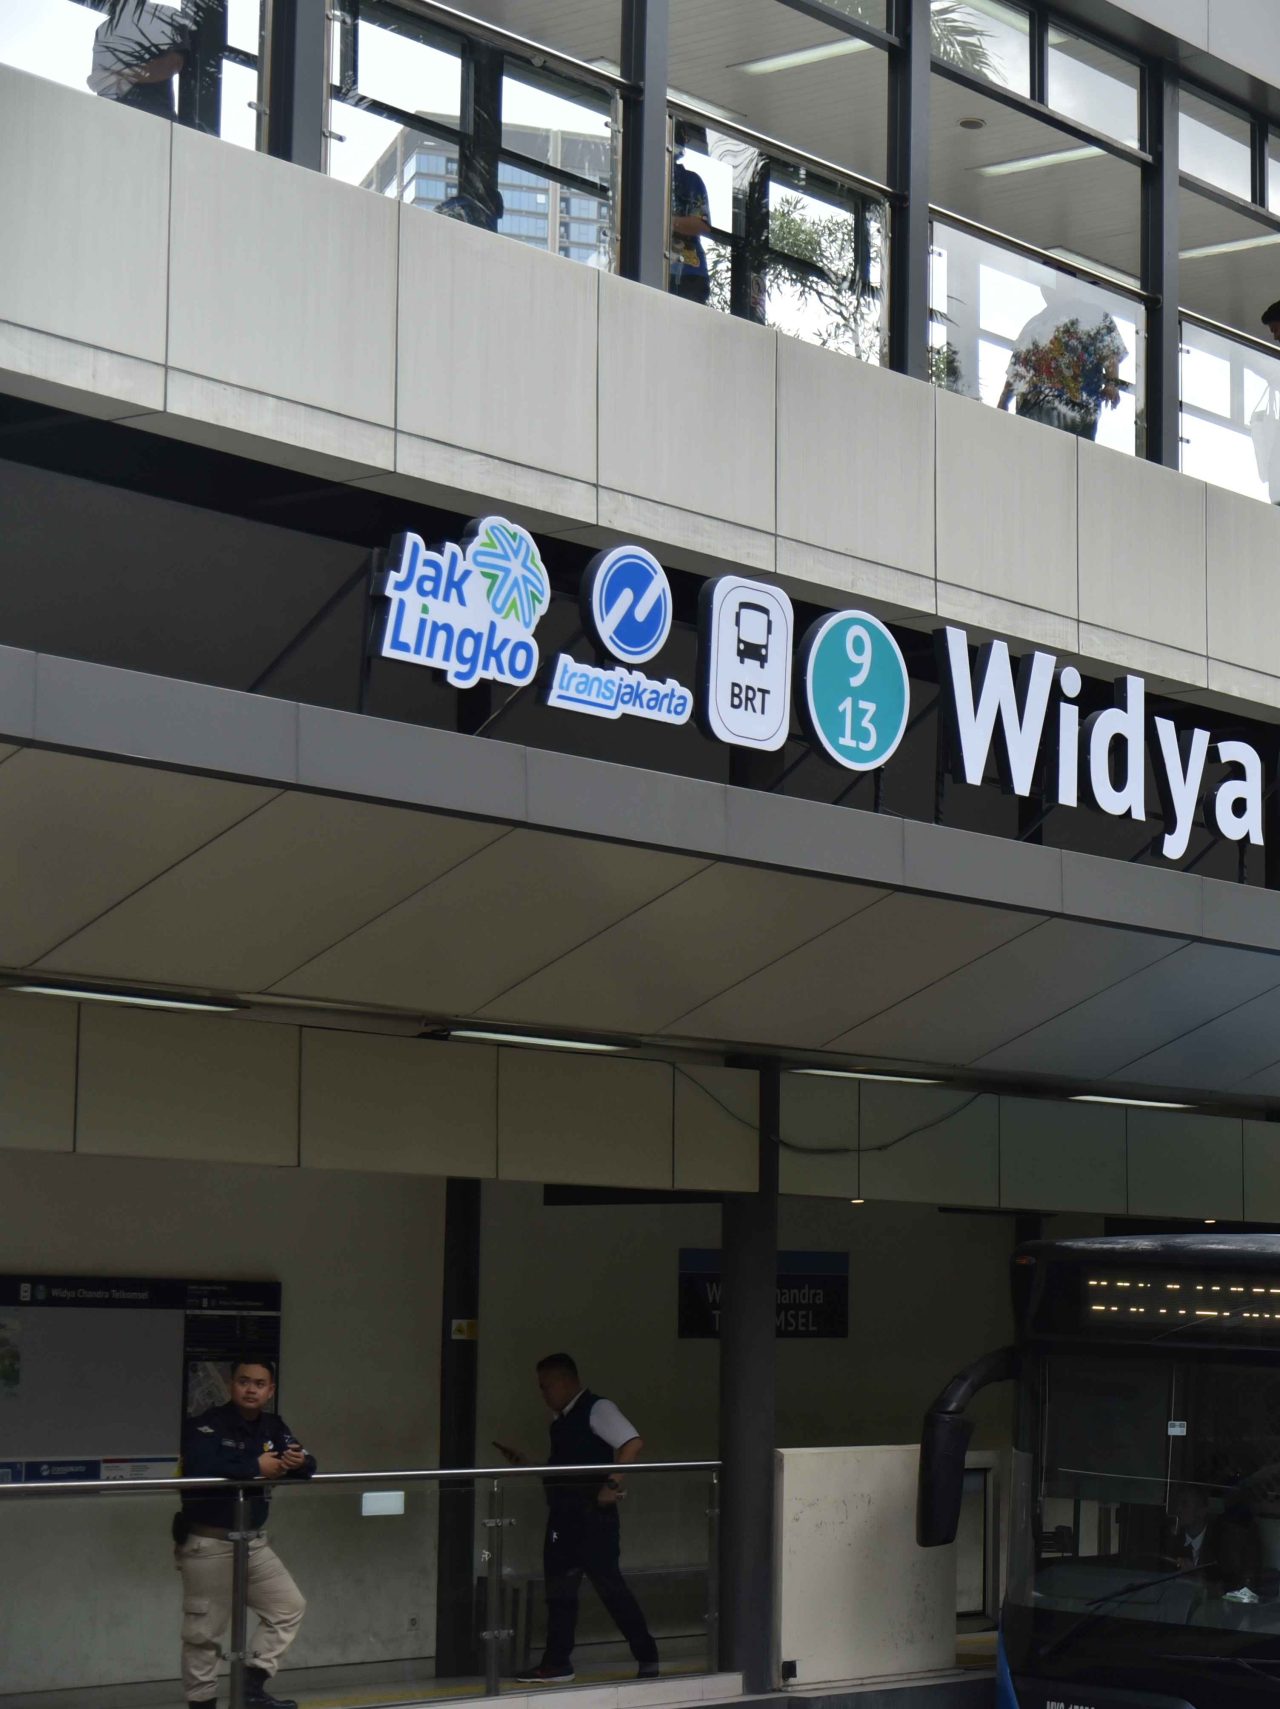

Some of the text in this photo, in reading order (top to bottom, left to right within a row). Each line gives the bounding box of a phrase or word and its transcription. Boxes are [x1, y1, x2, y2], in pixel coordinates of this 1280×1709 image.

[394, 540, 471, 608] Jak
[390, 597, 534, 682] Lingko
[846, 624, 872, 688] 9
[556, 662, 689, 716] transjakarta
[730, 682, 771, 716] BRT
[838, 696, 878, 752] 13
[946, 625, 1265, 860] Widya
